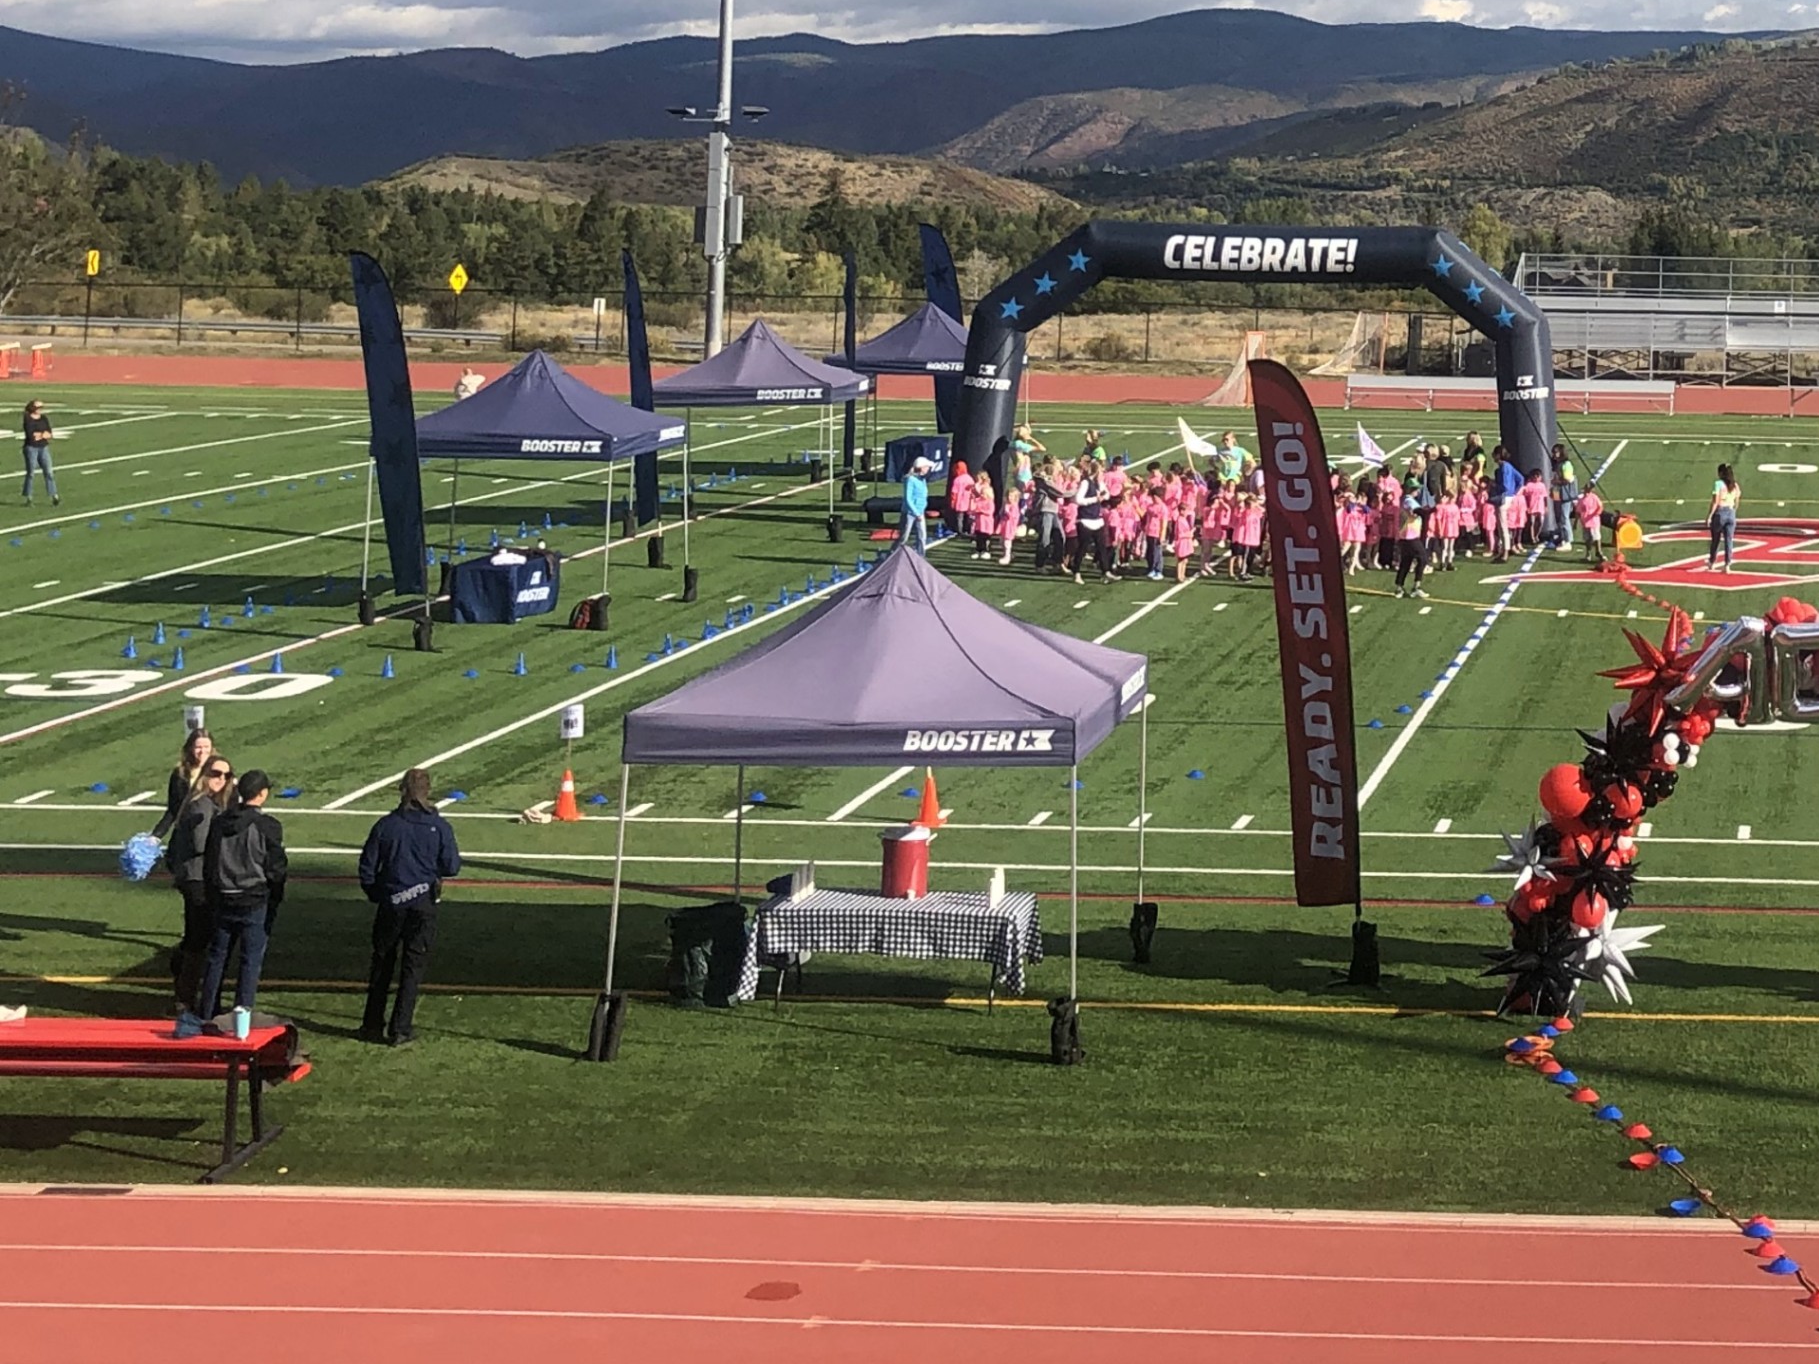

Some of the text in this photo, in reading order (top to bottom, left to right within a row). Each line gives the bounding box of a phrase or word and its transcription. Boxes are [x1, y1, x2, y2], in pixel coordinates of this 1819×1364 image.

[1163, 234, 1358, 273] CELEBRATE!
[756, 389, 806, 400] BOOSTER
[1503, 387, 1549, 400] BOOSTER
[520, 439, 582, 453] BOOSTER
[1271, 421, 1346, 860] READY. SET. GO!
[903, 730, 1016, 752] BOOSTER
